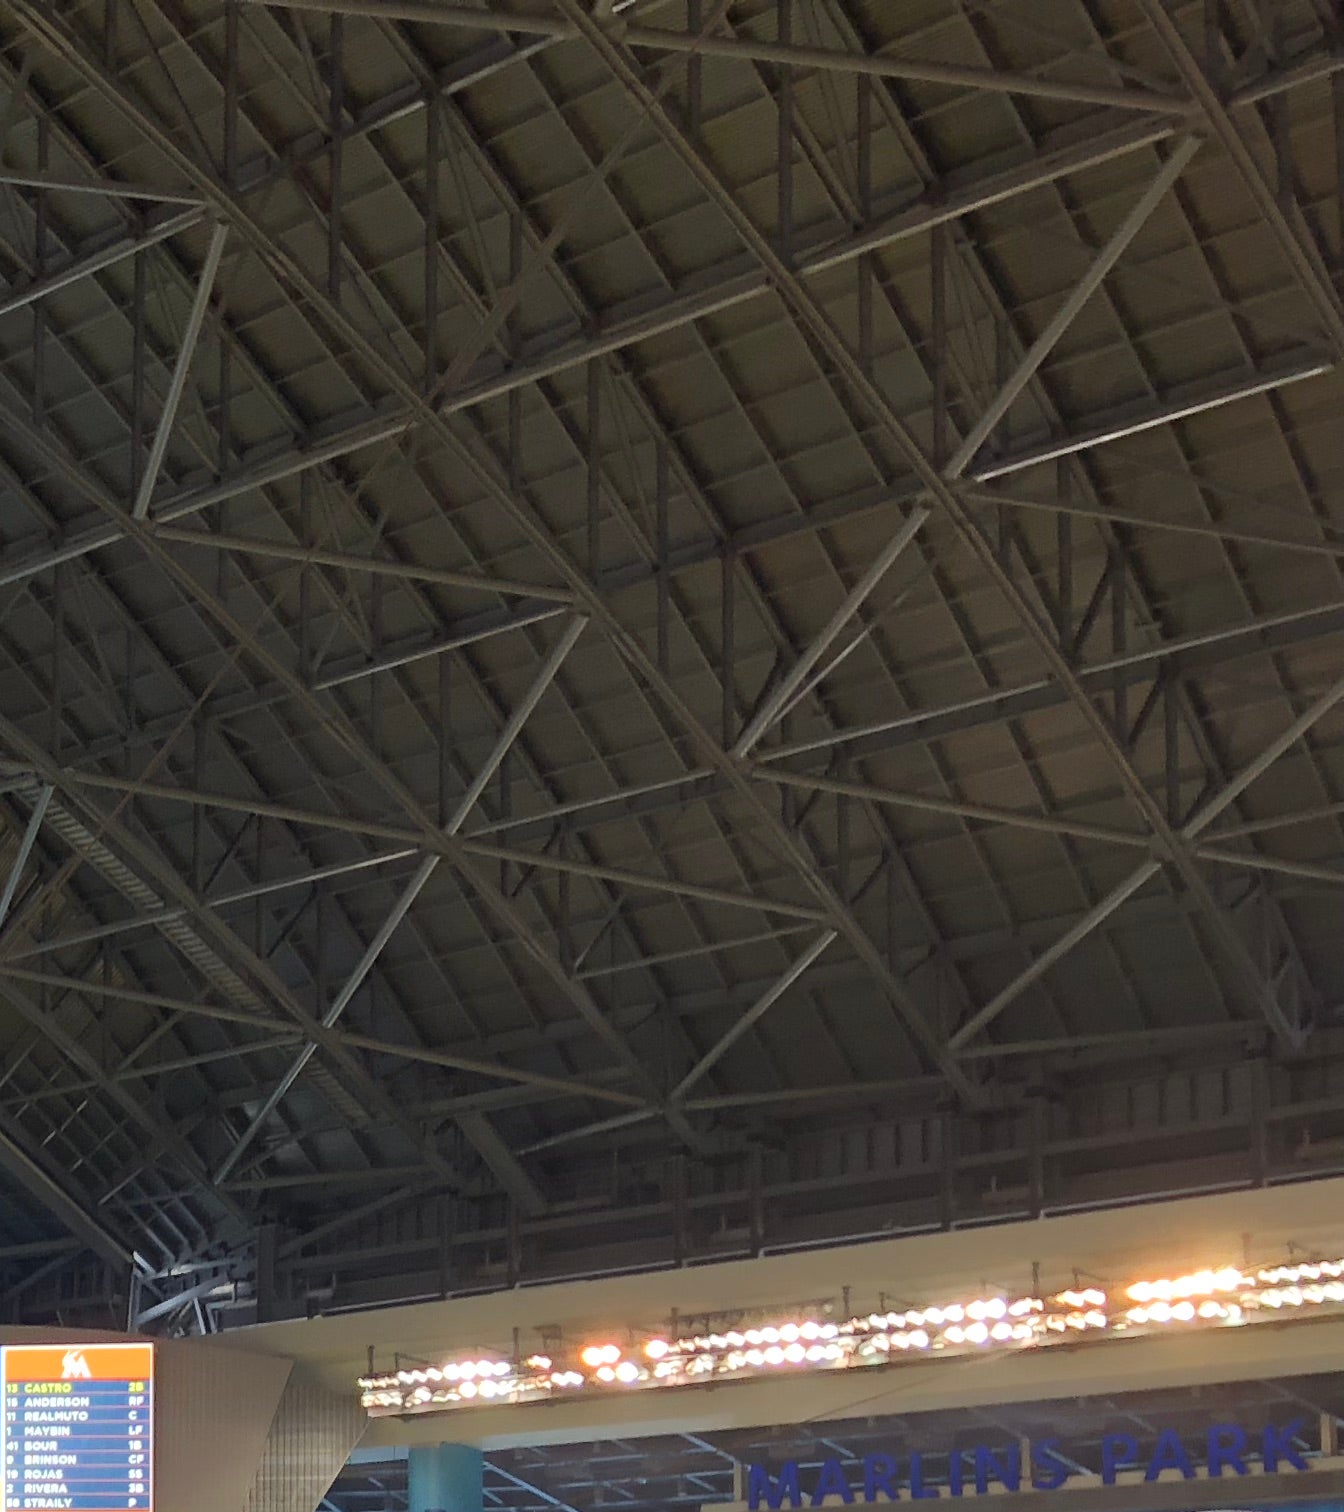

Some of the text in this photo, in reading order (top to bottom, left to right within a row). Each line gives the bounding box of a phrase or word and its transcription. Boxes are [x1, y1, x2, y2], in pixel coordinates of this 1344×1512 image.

[24, 1383, 72, 1393] CASTRO
[24, 1397, 90, 1407] ANDERSON
[24, 1411, 88, 1421] REALMUTO
[748, 1419, 1310, 1510] MARLINS PARK
[24, 1469, 63, 1479] ROJAS
[24, 1484, 68, 1493] RIVERA
[24, 1498, 72, 1508] STRAILY
